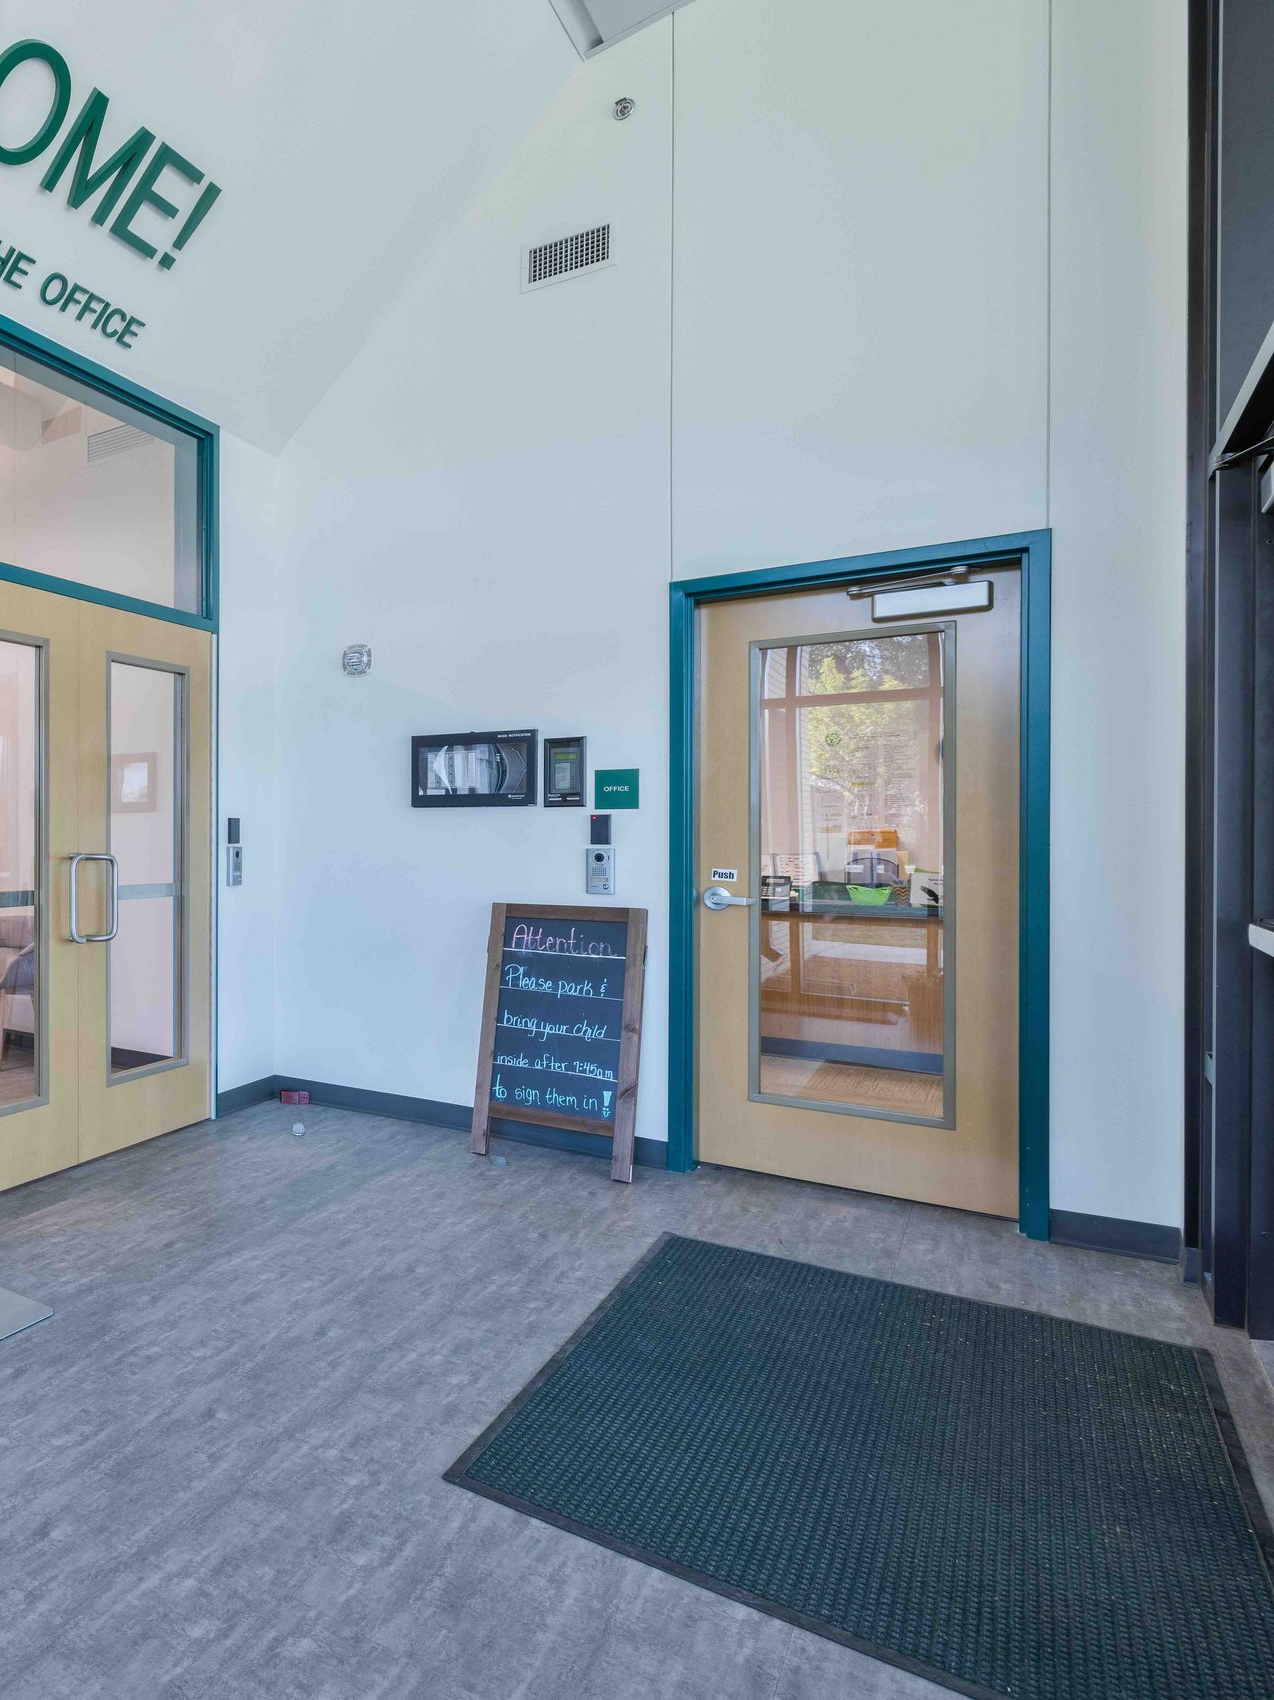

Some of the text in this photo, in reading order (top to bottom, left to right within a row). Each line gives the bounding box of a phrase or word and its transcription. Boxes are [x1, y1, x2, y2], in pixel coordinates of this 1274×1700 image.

[39, 271, 146, 349] OFFICE
[603, 785, 630, 793] OFFICE
[713, 870, 734, 880] Push
[511, 924, 617, 956] Attention
[504, 963, 552, 991] Please
[557, 980, 593, 998] park
[503, 1009, 607, 1042] bring your child
[497, 1052, 614, 1080] inside after 7:45am
[492, 1074, 507, 1098] to
[515, 1086, 541, 1106] sign
[545, 1088, 579, 1110] them
